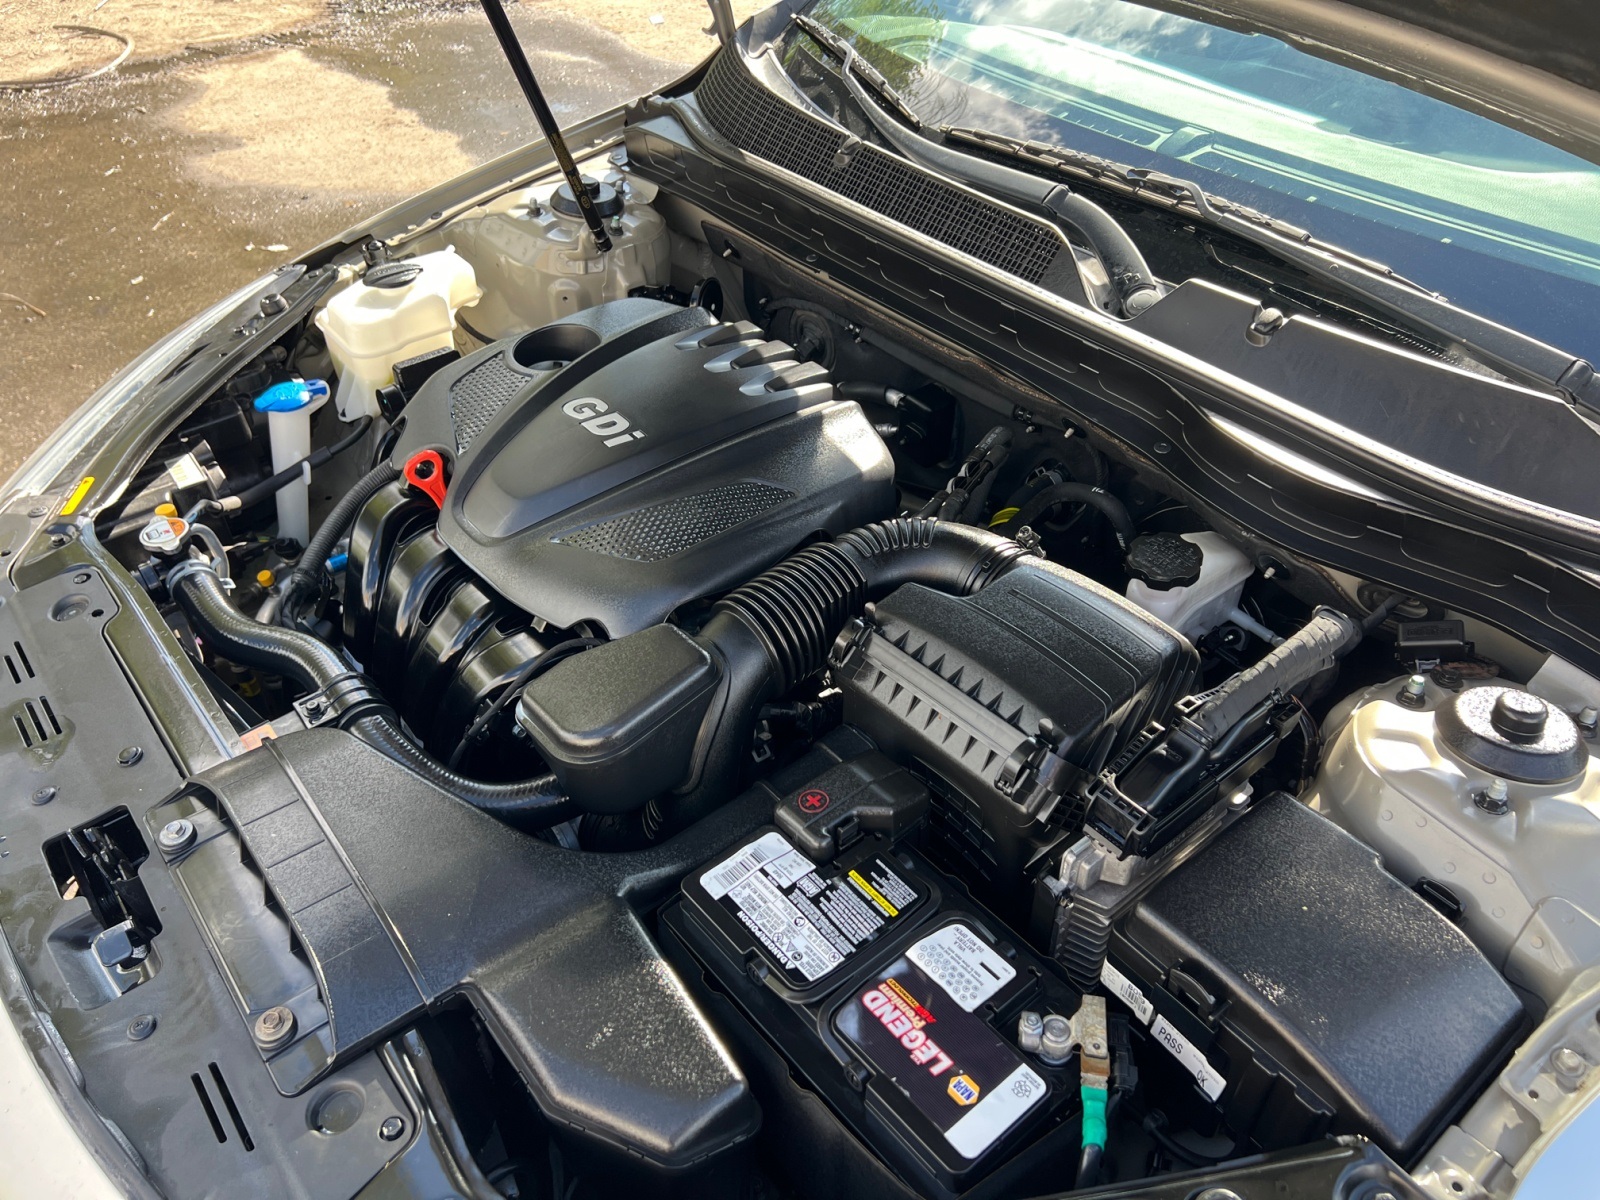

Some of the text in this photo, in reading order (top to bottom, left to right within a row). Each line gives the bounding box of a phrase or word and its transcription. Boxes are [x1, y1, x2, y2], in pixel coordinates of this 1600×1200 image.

[562, 397, 646, 448] GDi
[735, 909, 789, 965] DANGER/POISON
[955, 934, 976, 953] BATTERY
[965, 936, 977, 947] NOT
[975, 944, 984, 953] DO
[877, 981, 927, 1029] Premium
[886, 977, 919, 1007] TECHNOLOGY
[913, 1002, 937, 1023] AGM
[862, 989, 955, 1077] LEGEND
[1158, 1026, 1184, 1055] PASS
[952, 1077, 975, 1101] NAPA
